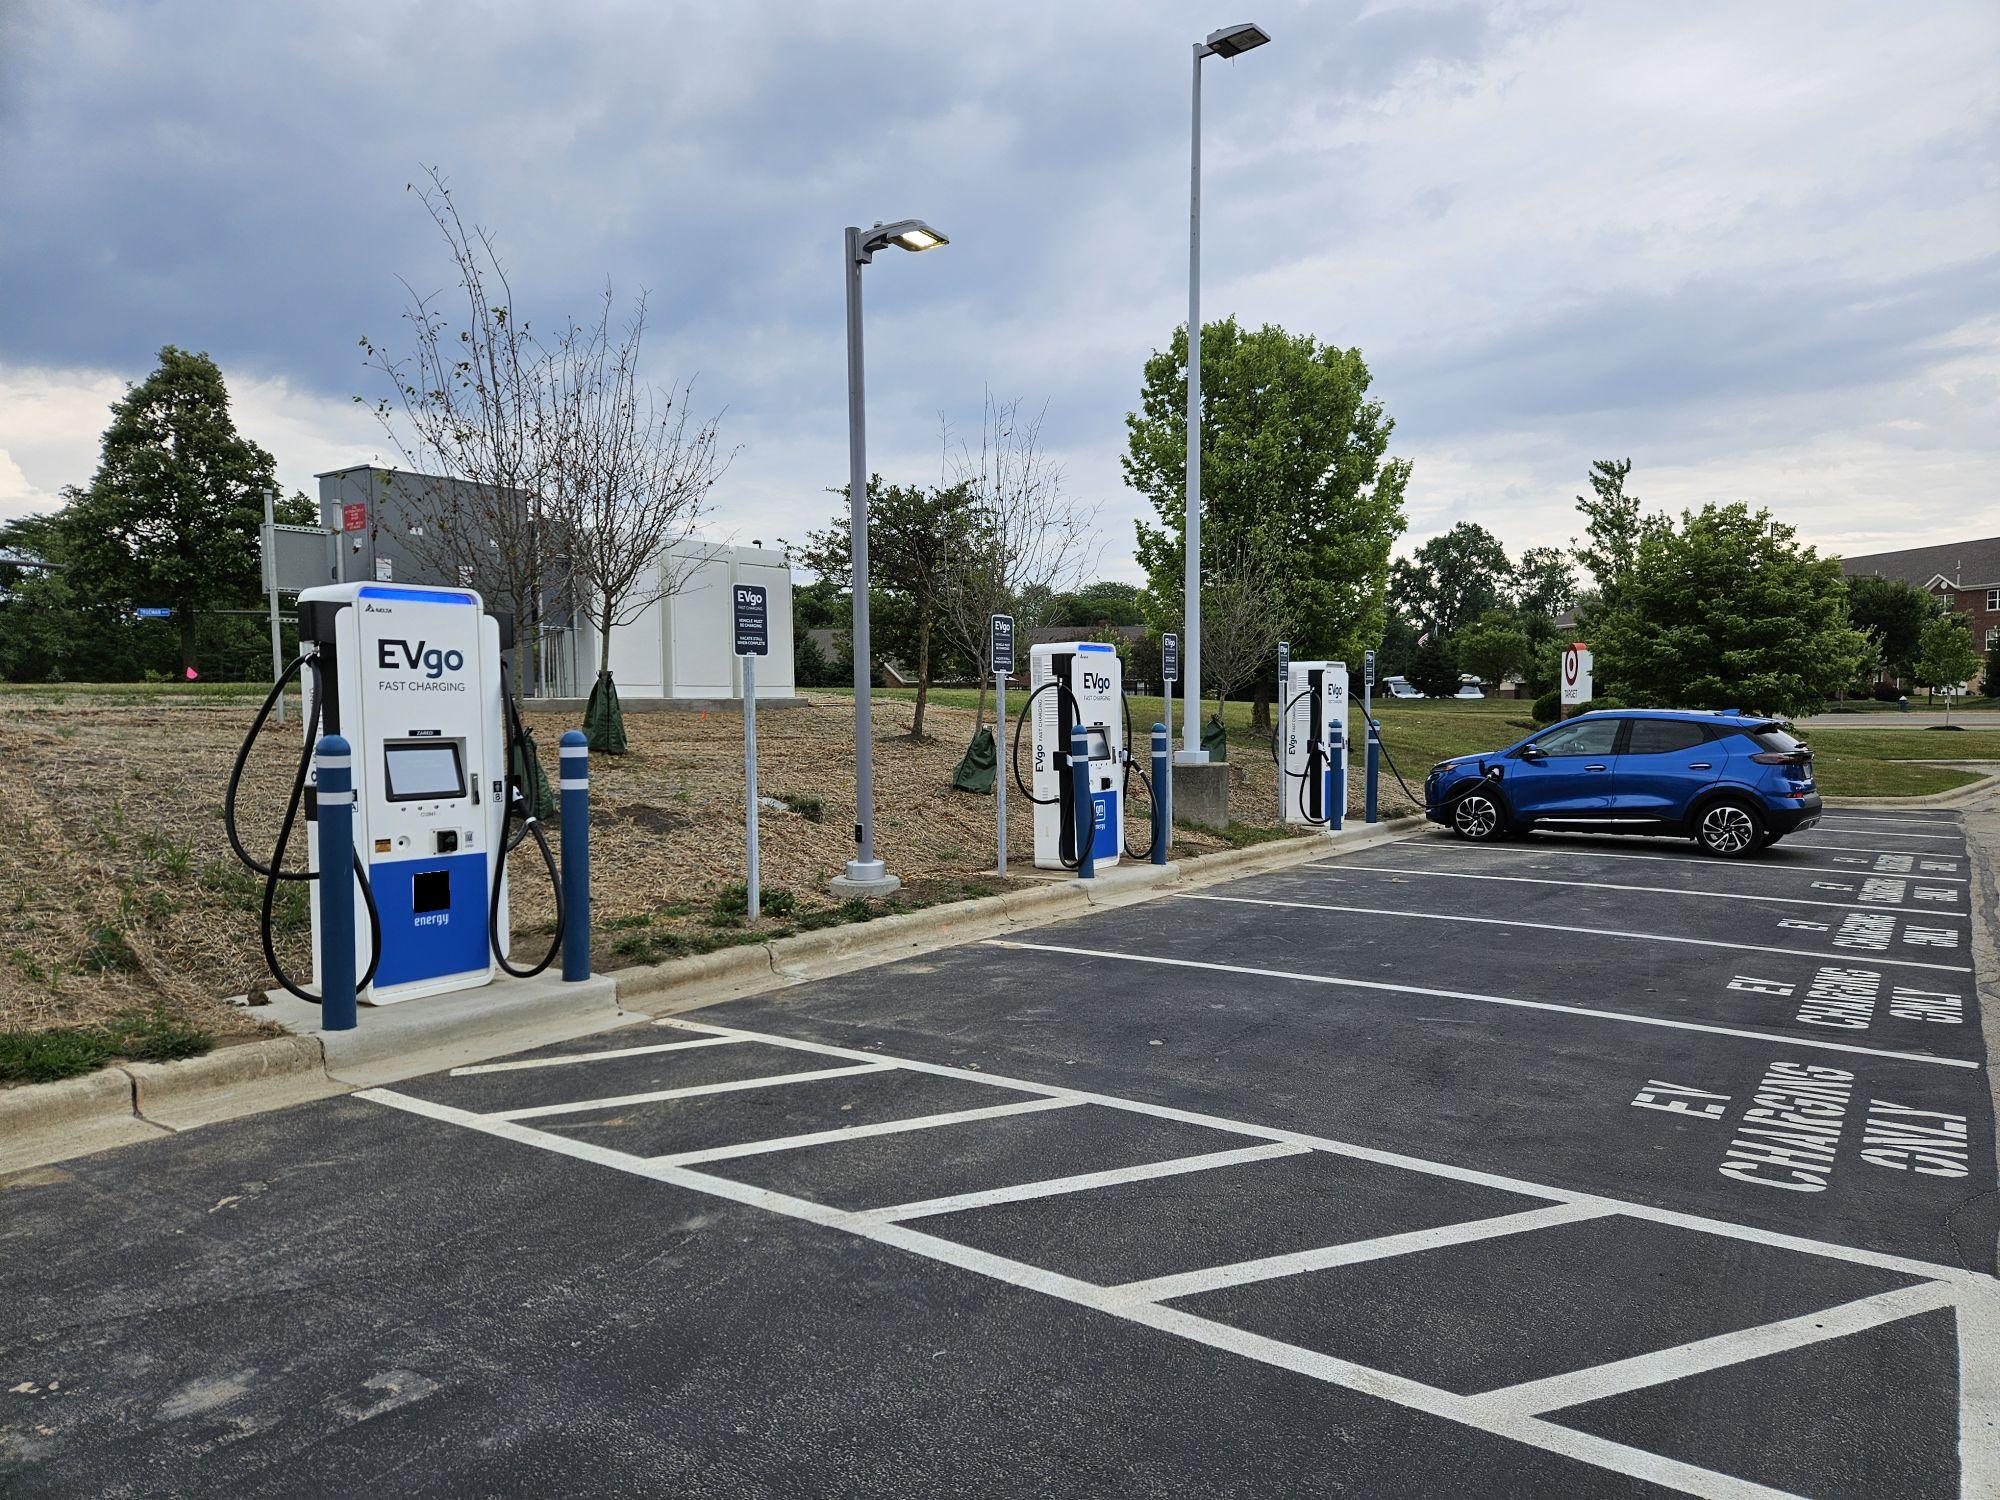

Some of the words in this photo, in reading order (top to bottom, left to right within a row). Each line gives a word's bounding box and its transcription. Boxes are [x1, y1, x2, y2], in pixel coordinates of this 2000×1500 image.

[737, 590, 763, 606] EVgo
[994, 620, 1011, 633] EVgo
[377, 638, 464, 679] EVgo
[378, 681, 406, 691] FAST
[408, 681, 466, 692] CHARGING
[1083, 672, 1111, 694] EVgo
[1327, 683, 1343, 699] EVgo
[1288, 734, 1298, 755] EVgo
[1035, 744, 1046, 773] EVgo
[414, 913, 449, 927] energy
[1726, 975, 1796, 996] EV
[1796, 967, 1881, 1029] CHARGING
[1889, 986, 1963, 1023] ONLY
[1630, 1079, 1731, 1120] EV
[1718, 1061, 1855, 1192] CHARGING
[1860, 1099, 1969, 1178] ONLY
